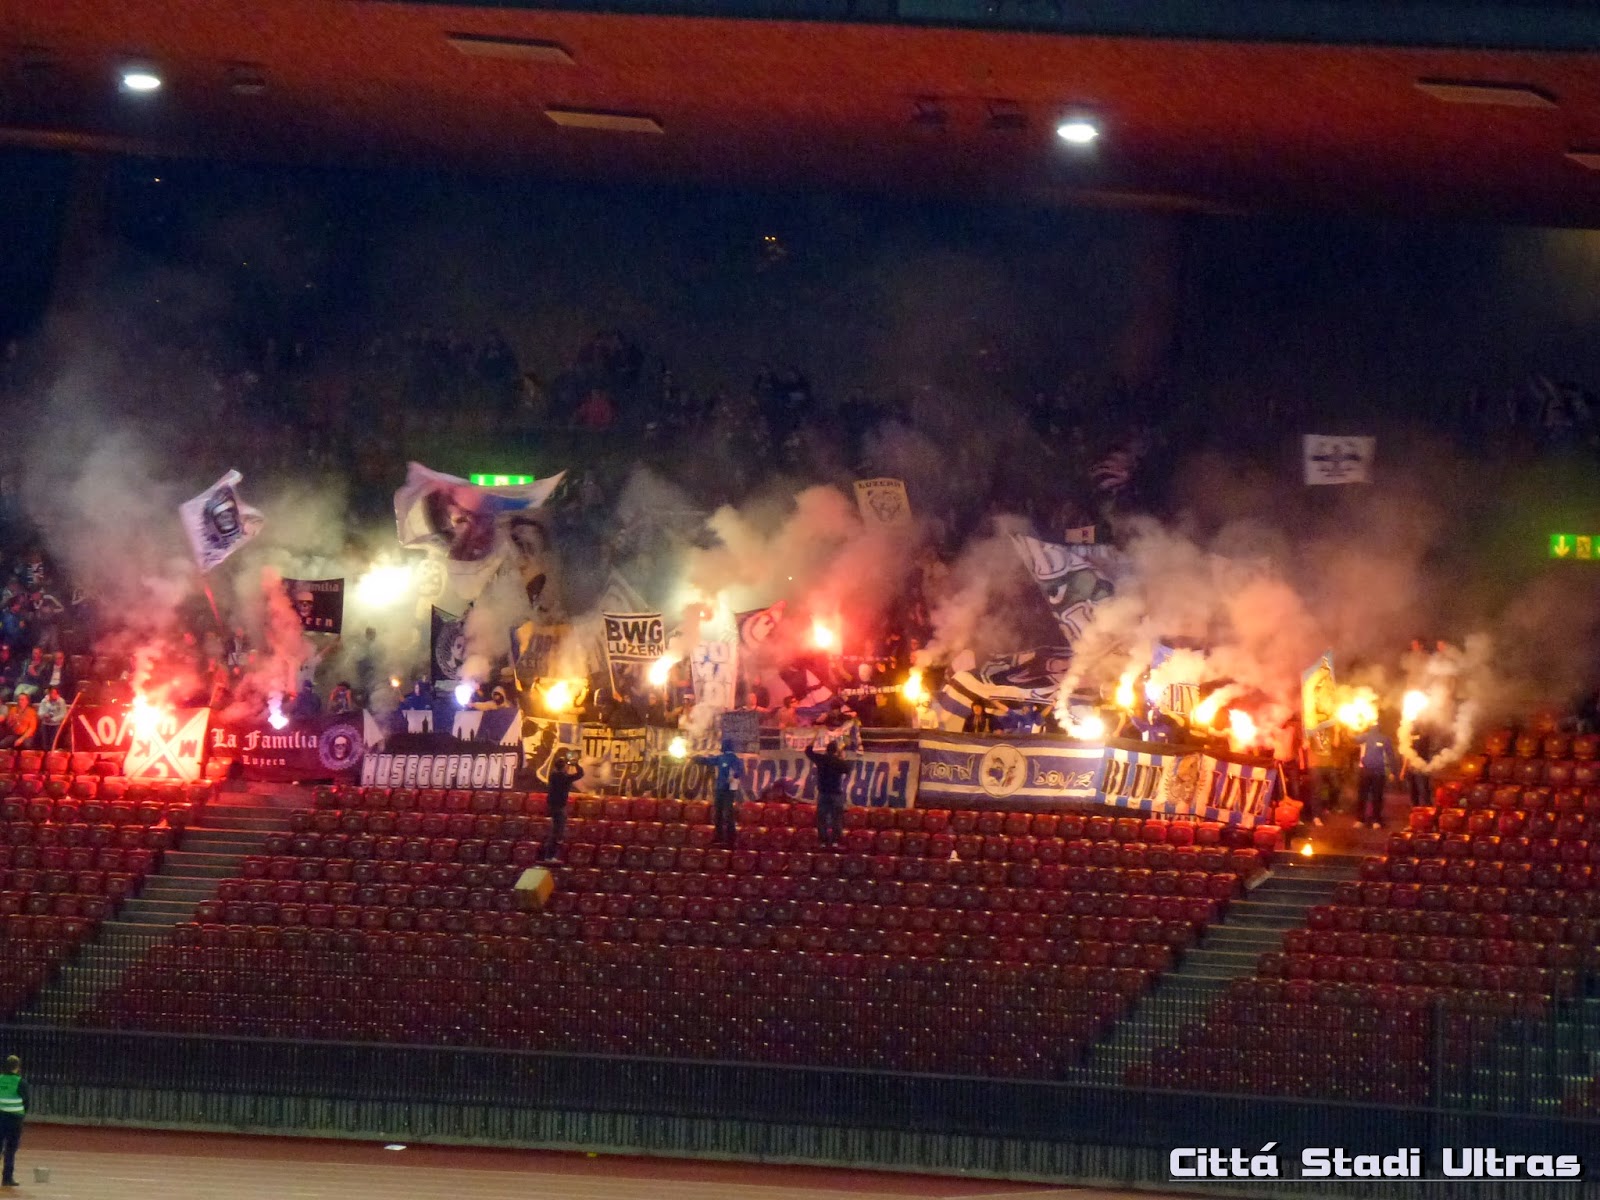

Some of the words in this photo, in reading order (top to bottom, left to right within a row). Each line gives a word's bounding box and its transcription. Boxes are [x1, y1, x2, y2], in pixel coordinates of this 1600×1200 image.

[605, 618, 662, 644] BWG
[607, 641, 664, 657] LUZERN
[210, 728, 237, 748] La
[242, 730, 318, 751] Familia
[242, 755, 286, 767] Luzern
[361, 752, 518, 789] MUSEGGFRONT
[921, 754, 976, 781] nord
[1032, 758, 1095, 792] boyz
[1100, 758, 1164, 800] BLUE
[1206, 769, 1272, 817] LINE
